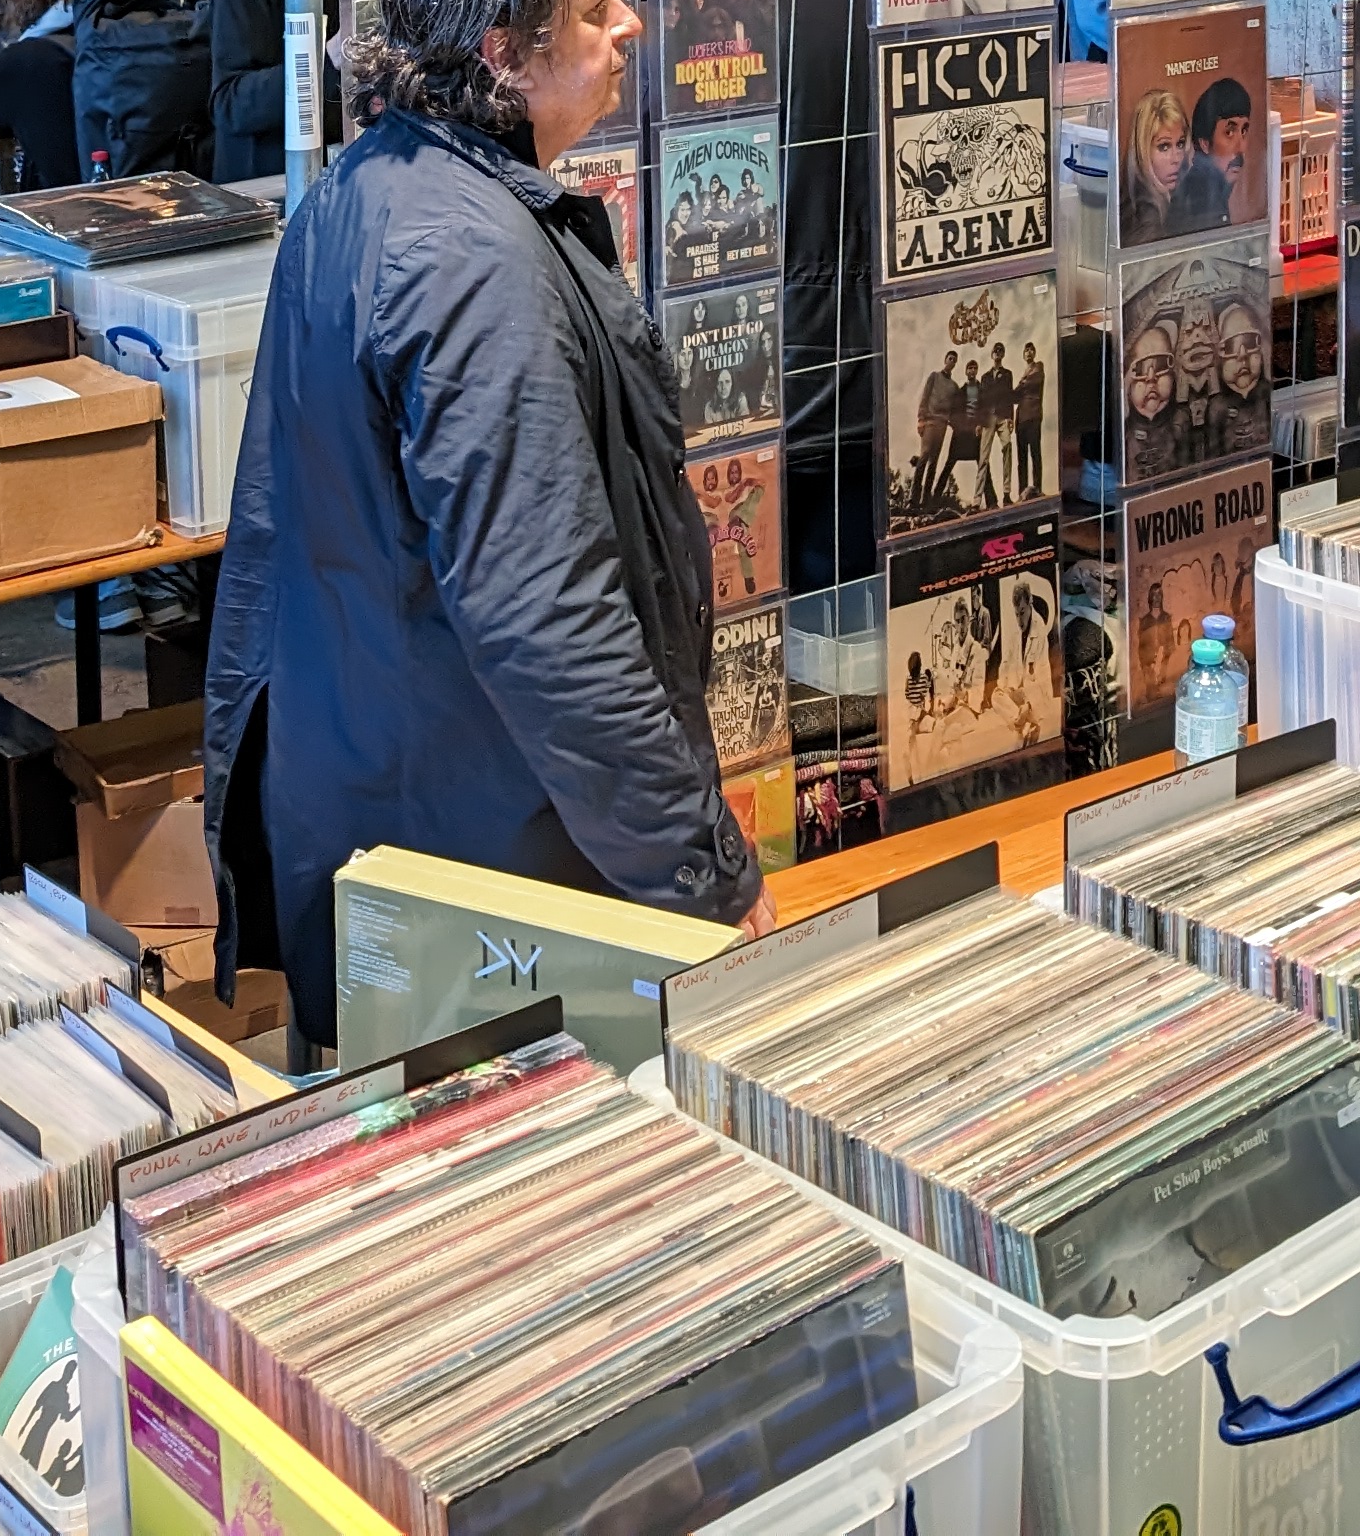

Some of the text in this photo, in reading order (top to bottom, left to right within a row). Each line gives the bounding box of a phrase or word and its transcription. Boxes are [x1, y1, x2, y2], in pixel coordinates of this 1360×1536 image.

[1203, 56, 1219, 70] LEE
[695, 78, 747, 103] SINGER
[578, 160, 622, 179] MARLEEN
[671, 140, 769, 188] AMEN CORNER
[901, 206, 1043, 268] ARENA
[686, 243, 719, 257] PARADISE
[703, 255, 720, 265] HALF
[693, 268, 702, 278] AS
[683, 320, 763, 349] DON'T LET GO
[699, 338, 749, 361] DRAGON
[705, 352, 744, 372] CHILD
[1135, 482, 1265, 553] WRONG ROAD
[920, 551, 1055, 593] THE COST OF LOVING
[719, 740, 746, 761] ROCK
[1154, 1127, 1272, 1206] Pet Shop Boys, actually
[42, 1337, 74, 1364] THE
